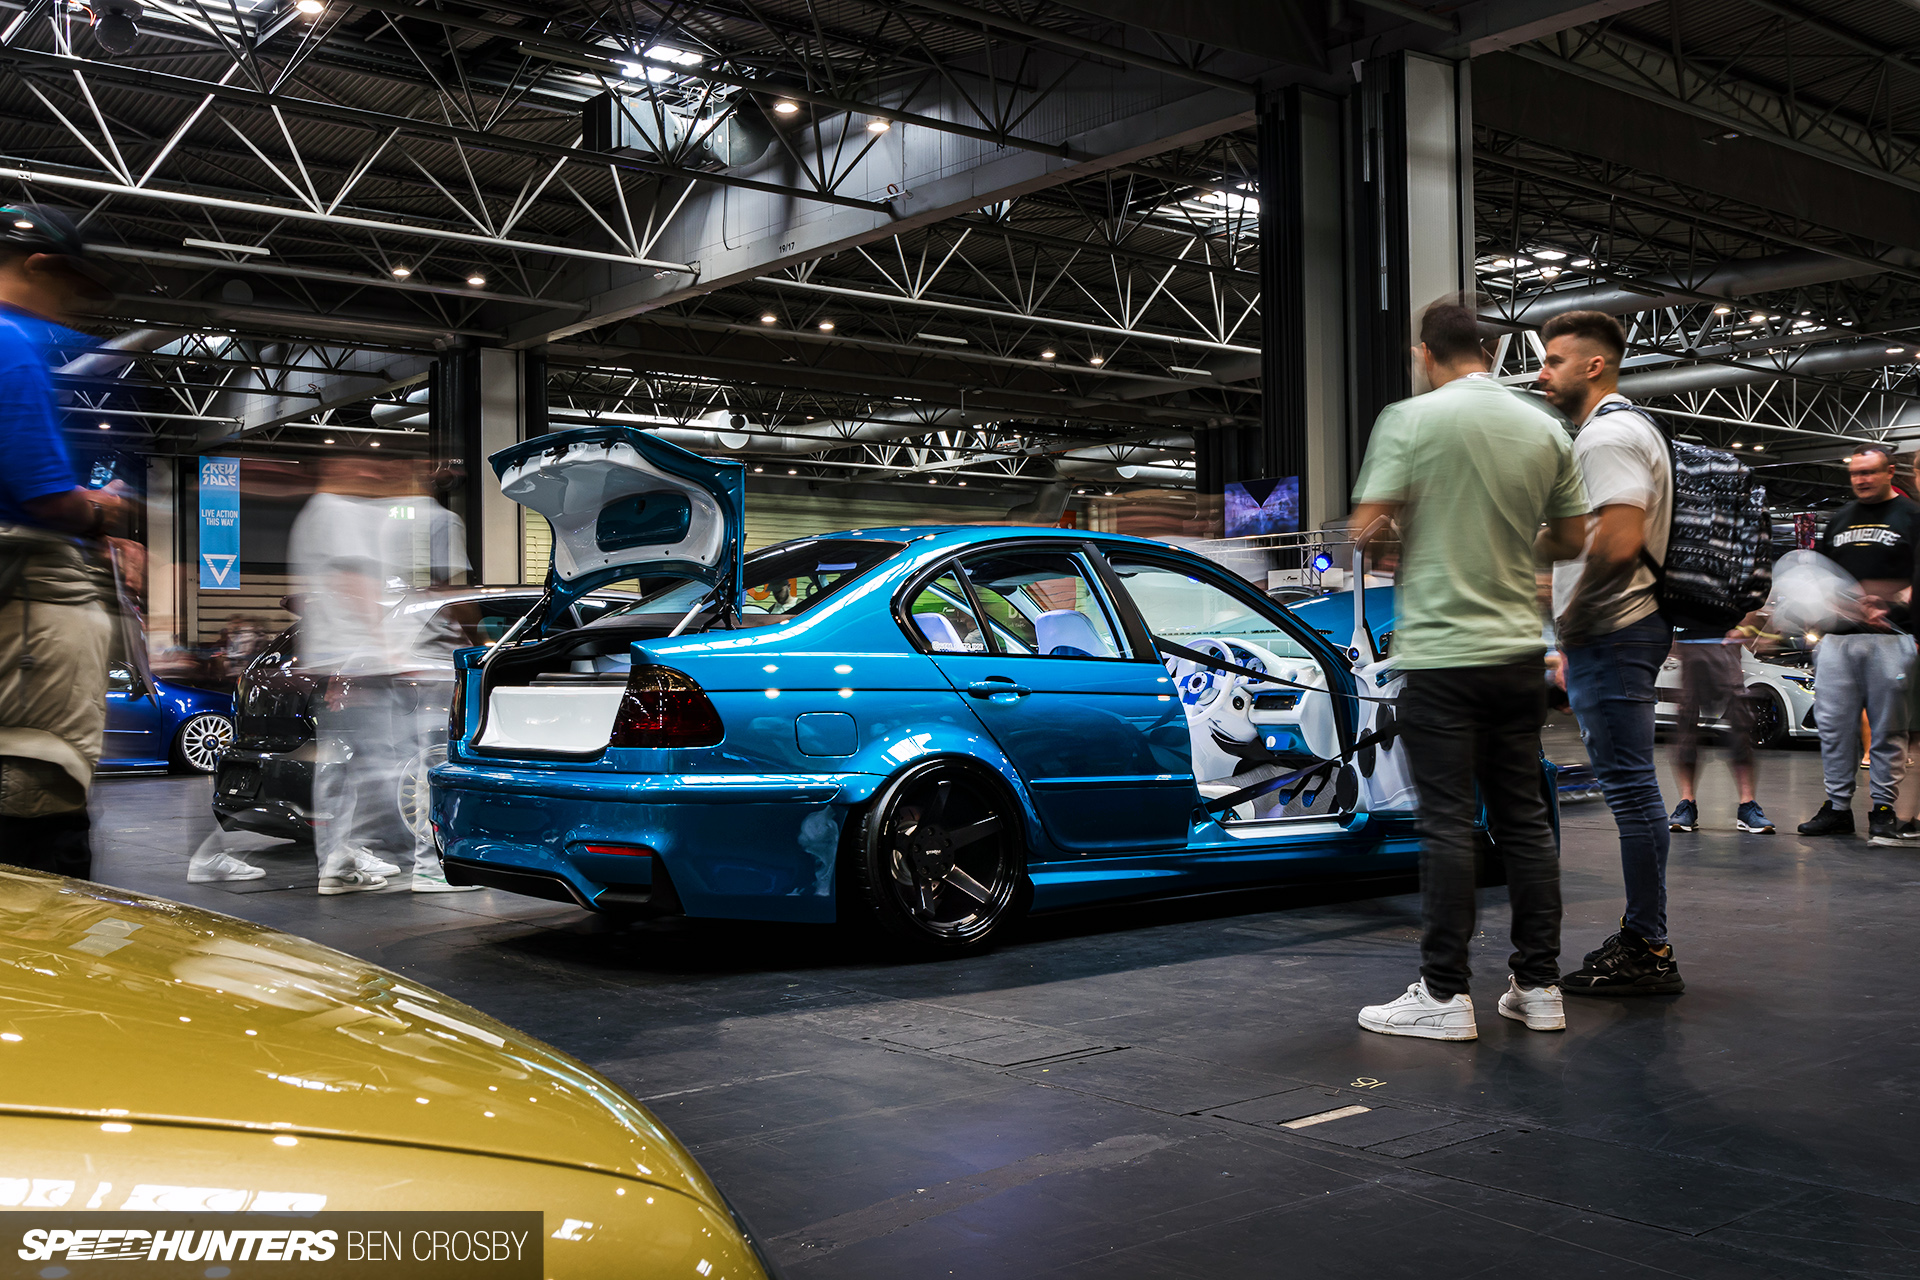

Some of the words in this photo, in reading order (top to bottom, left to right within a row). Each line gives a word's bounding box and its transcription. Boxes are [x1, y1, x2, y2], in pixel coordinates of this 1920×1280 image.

[779, 242, 795, 253] 19/17
[202, 463, 237, 475] CREW
[201, 509, 215, 518] LIVE
[216, 510, 238, 519] ACTION
[206, 518, 220, 526] THIS
